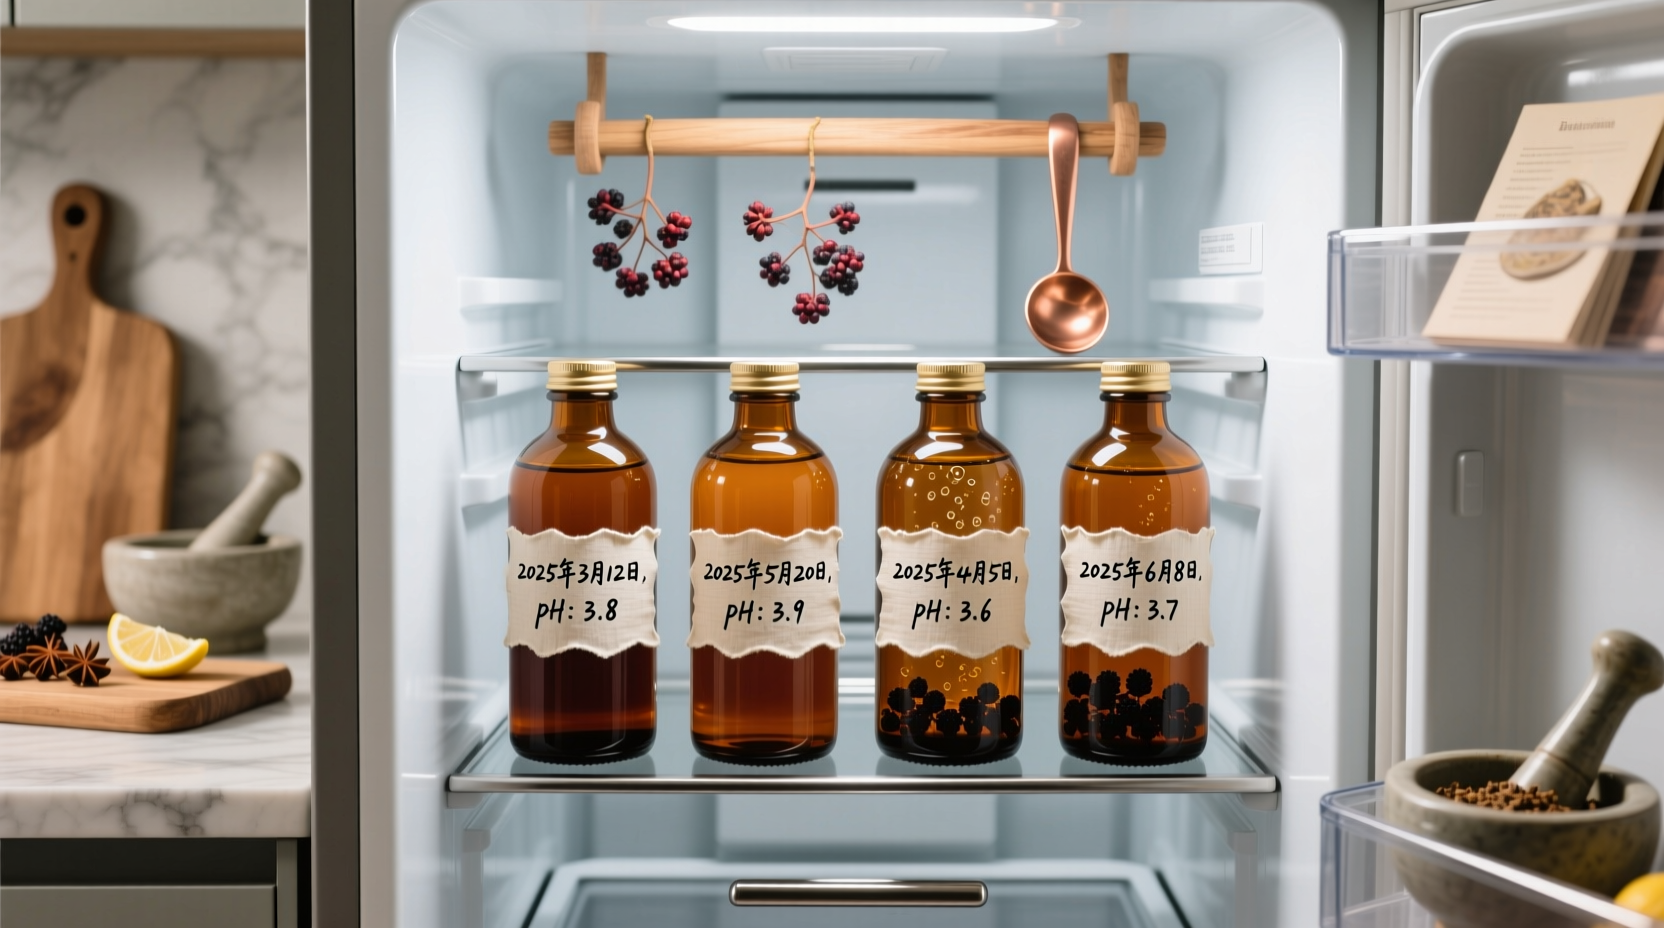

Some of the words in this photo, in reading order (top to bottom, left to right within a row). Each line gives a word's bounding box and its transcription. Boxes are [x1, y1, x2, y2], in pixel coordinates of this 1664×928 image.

[518, 557, 647, 590] 2025年3月12日,
[704, 558, 832, 590] 2025年5月20日,
[892, 557, 1018, 589] 2025年4月5日,
[1080, 557, 1202, 589] 2025年6月8日,
[535, 599, 572, 629] pH:
[583, 599, 618, 622] 3.8
[724, 600, 763, 630] pH:
[772, 600, 804, 624] 3.9
[911, 599, 950, 630] pH:
[959, 598, 992, 622] 3.6
[1100, 598, 1139, 628] pH:
[1147, 599, 1179, 621] 3.7
